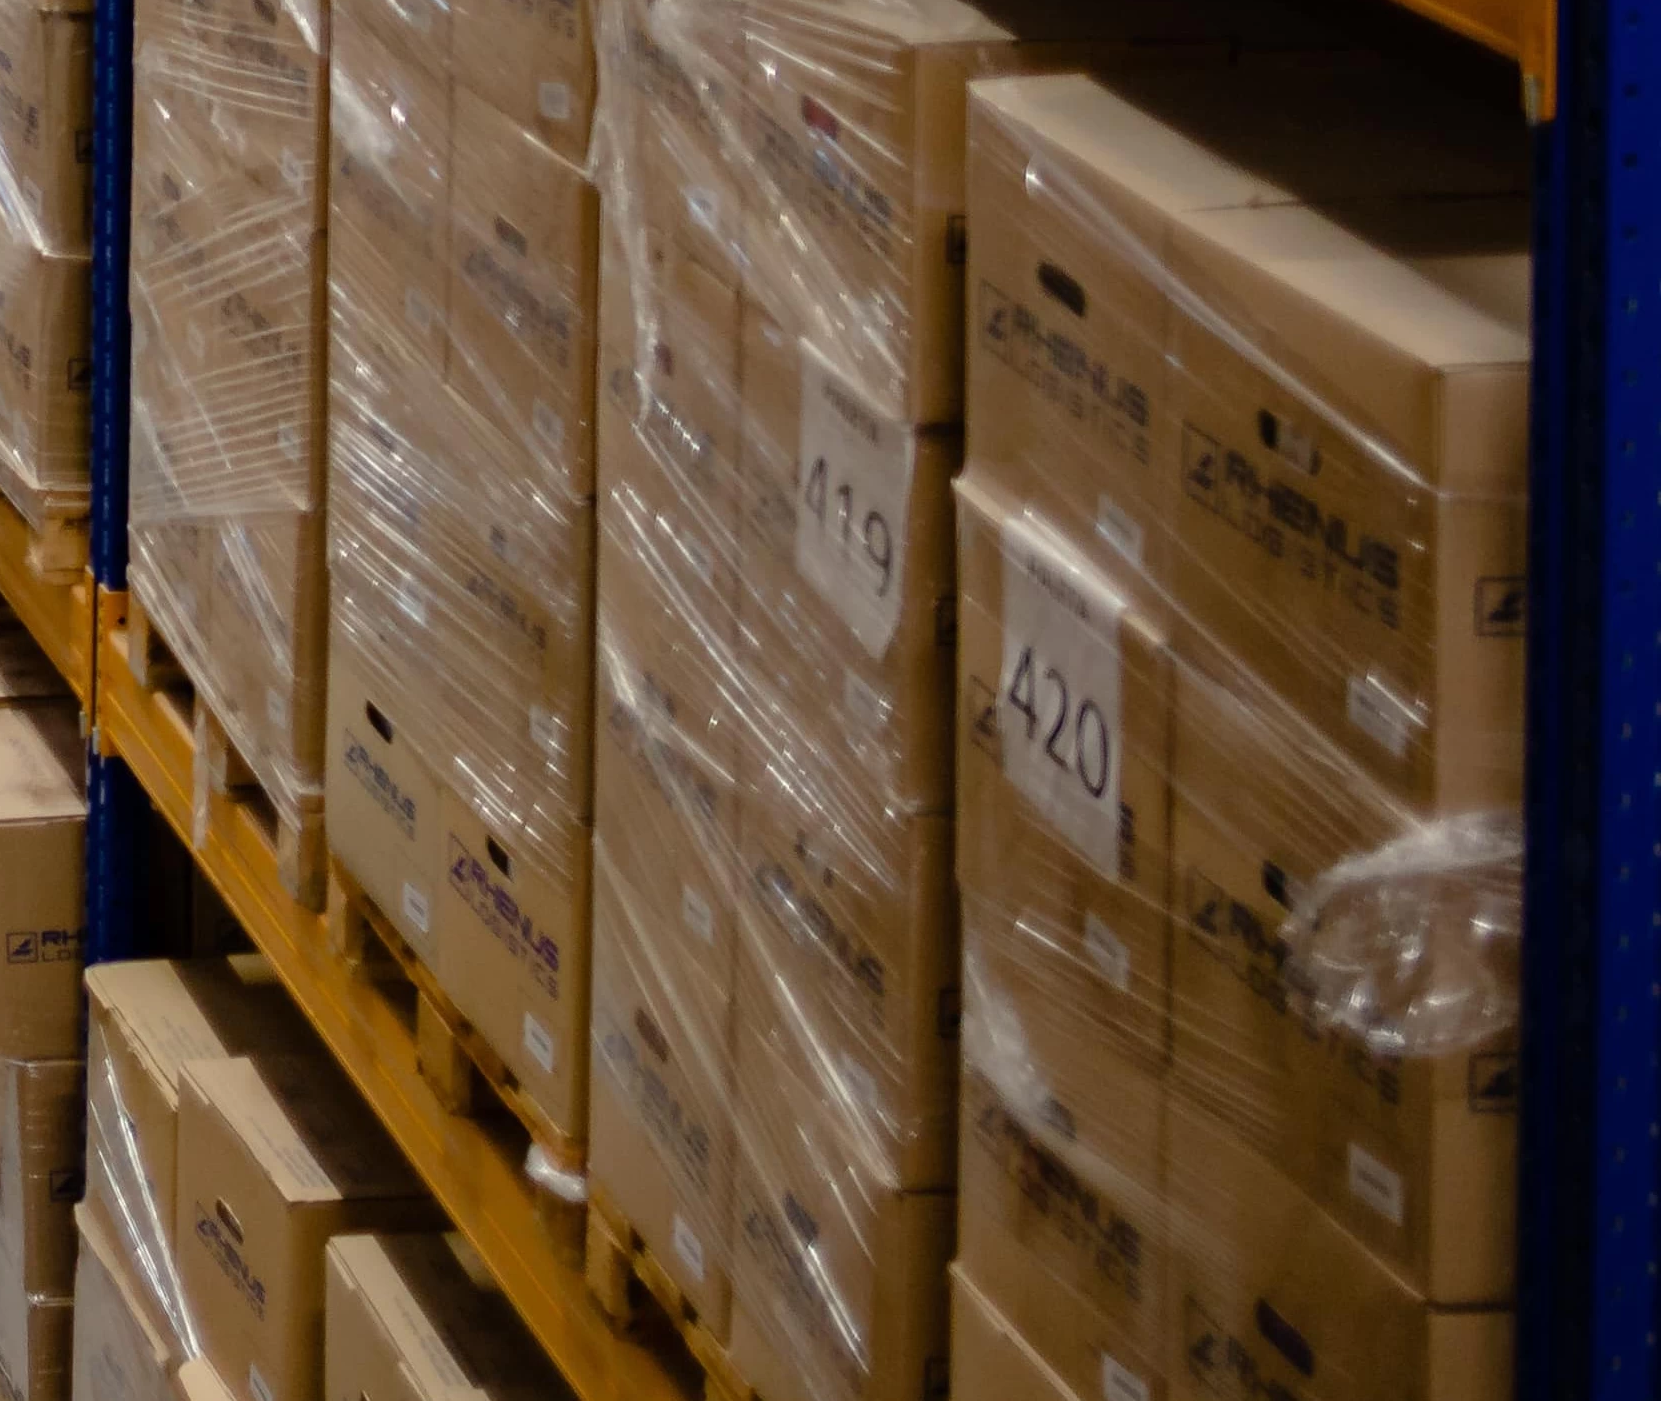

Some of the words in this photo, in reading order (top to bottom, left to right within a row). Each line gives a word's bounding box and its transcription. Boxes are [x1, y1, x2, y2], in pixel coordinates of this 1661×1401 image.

[806, 454, 894, 599] 419
[1225, 448, 1398, 591] RHENUS
[1008, 646, 1112, 798] 420
[471, 858, 559, 973] RHENUS
